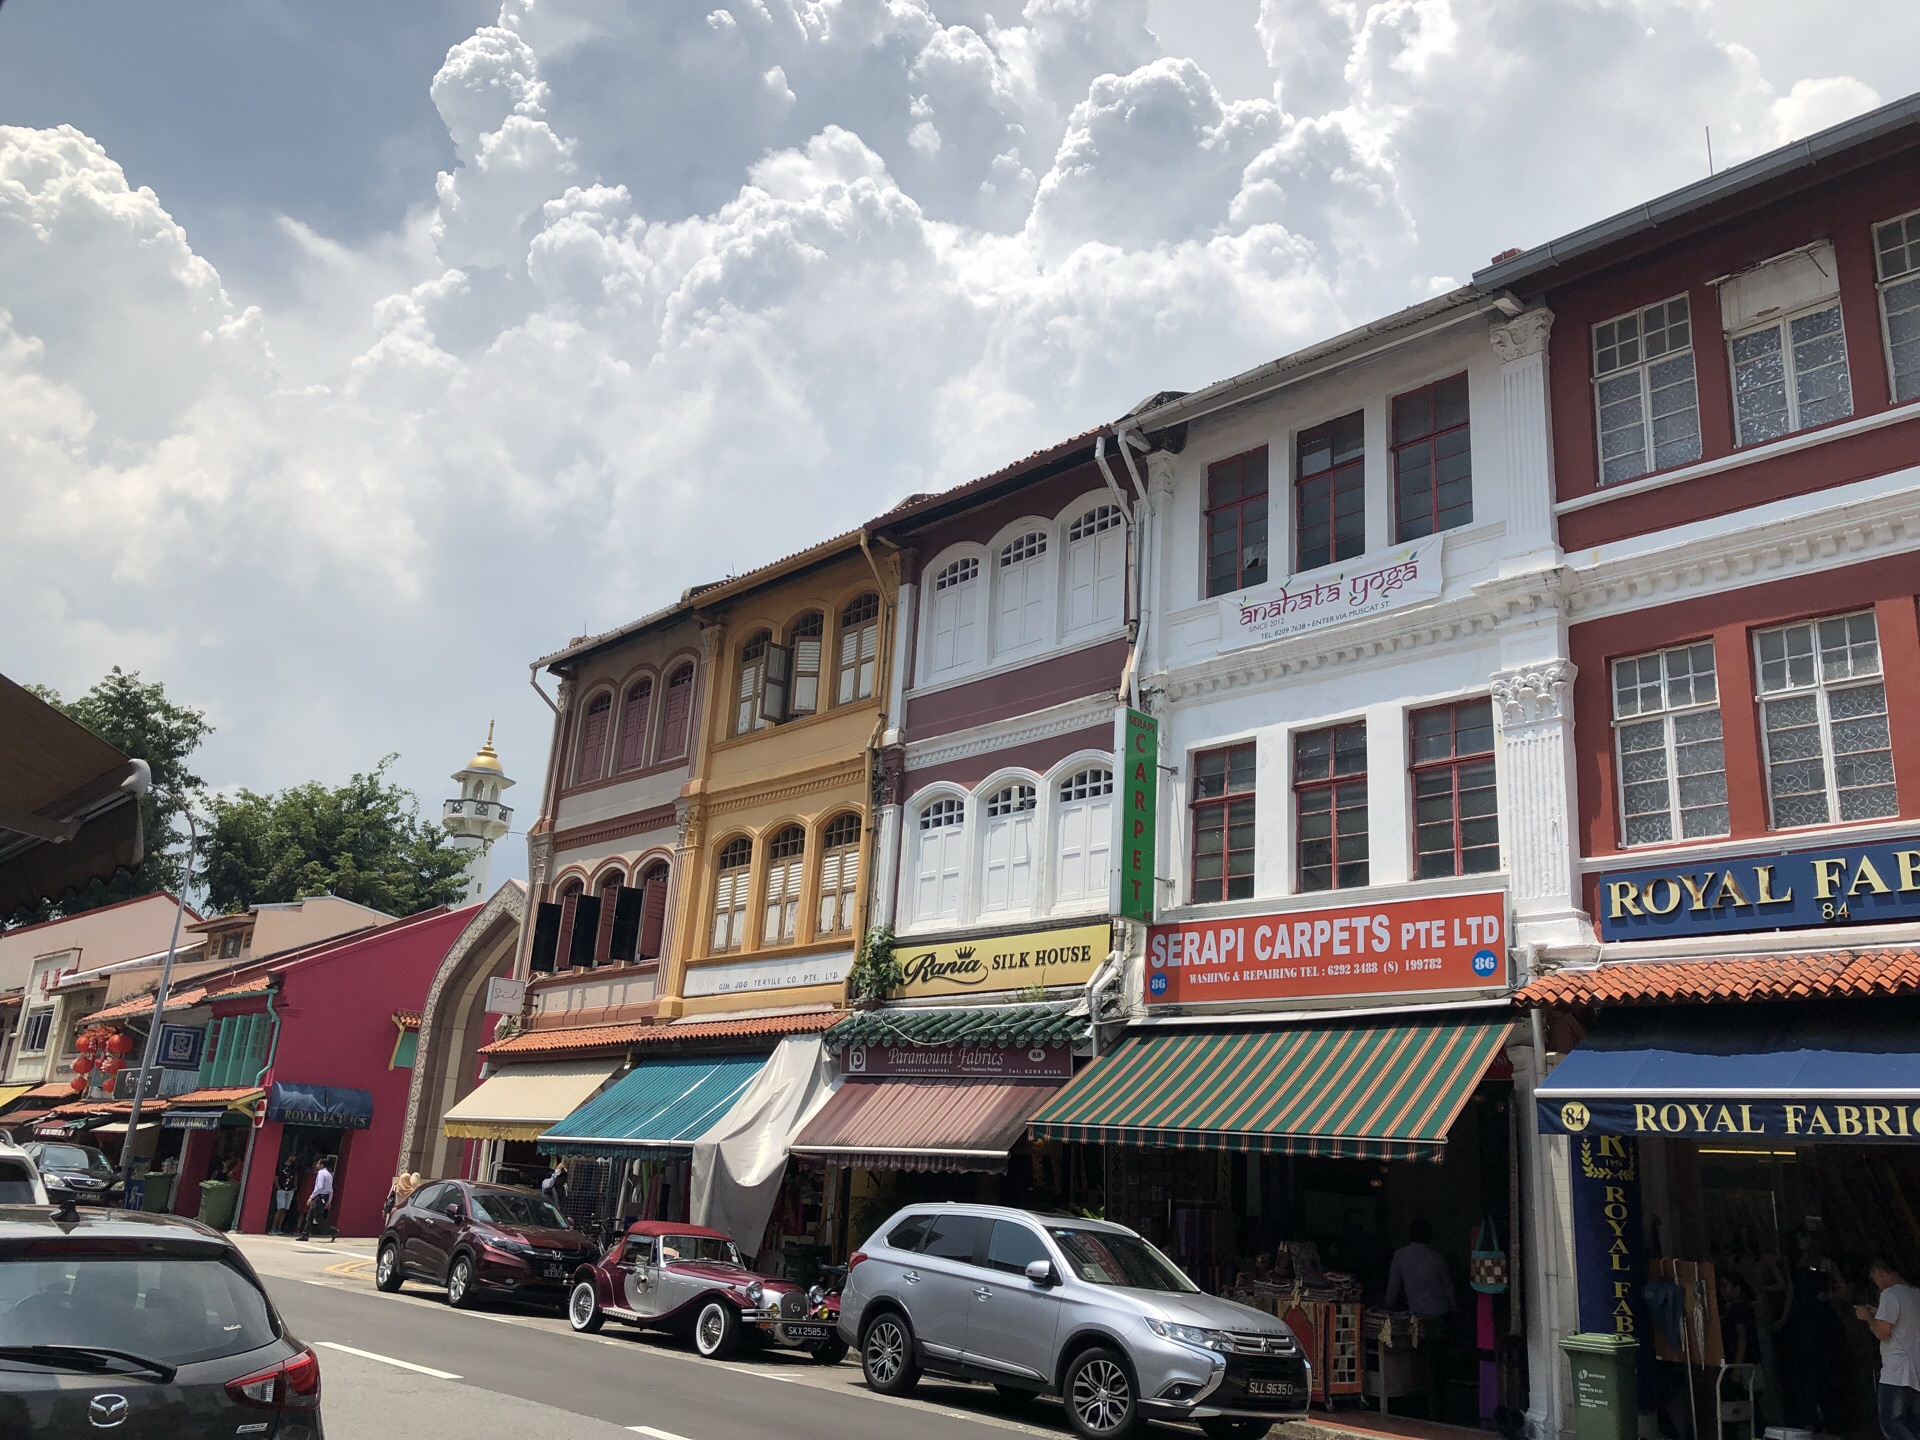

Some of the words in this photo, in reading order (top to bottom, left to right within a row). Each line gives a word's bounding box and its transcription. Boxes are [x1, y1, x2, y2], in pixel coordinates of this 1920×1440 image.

[1239, 583, 1342, 626] anahata
[1349, 559, 1419, 607] yoga
[1248, 621, 1268, 633] SINCE
[1269, 617, 1285, 629] 2012
[1274, 626, 1290, 637] 8209
[1291, 623, 1306, 633] 7638
[1312, 616, 1334, 627] ENTER
[1335, 612, 1348, 622] VIA
[1349, 603, 1379, 617] MUSCAT
[1128, 714, 1156, 734] SERAPI
[1131, 733, 1147, 901] CARPET
[1606, 864, 1792, 919] ROYAL
[1821, 901, 1850, 921] 84
[1150, 927, 1245, 969] SERAPI
[1253, 914, 1391, 962] CARPETS
[1401, 919, 1446, 951] PTE
[1453, 915, 1500, 947] LTD
[900, 951, 989, 987] Rania
[992, 952, 1030, 971] SILK
[1035, 944, 1092, 967] HOUSE
[1189, 971, 1231, 984] WASHING
[1232, 972, 1241, 982] &
[1243, 968, 1298, 982] REPAIRING
[1327, 963, 1351, 976] 6292
[1353, 962, 1378, 974] 3488
[1383, 960, 1399, 975] (S)
[1405, 957, 1442, 972] 199782
[1474, 956, 1495, 970] 86
[754, 977, 782, 987] TEXTILE
[1150, 977, 1167, 990] 86
[887, 1047, 954, 1065] Paramount
[957, 1045, 1004, 1068] Fabrics
[1031, 1051, 1042, 1059] 88
[284, 1109, 320, 1122] ROYAL
[1565, 1106, 1586, 1126] 84
[1633, 1103, 1765, 1134] ROYAL
[1782, 1105, 1920, 1137] FABRI
[1603, 1185, 1631, 1271] ROYAL
[549, 1263, 563, 1271] SLA
[1611, 1281, 1635, 1338] FAB
[787, 1326, 827, 1337] SKX2585J
[1249, 1382, 1294, 1396] SLL9635D
